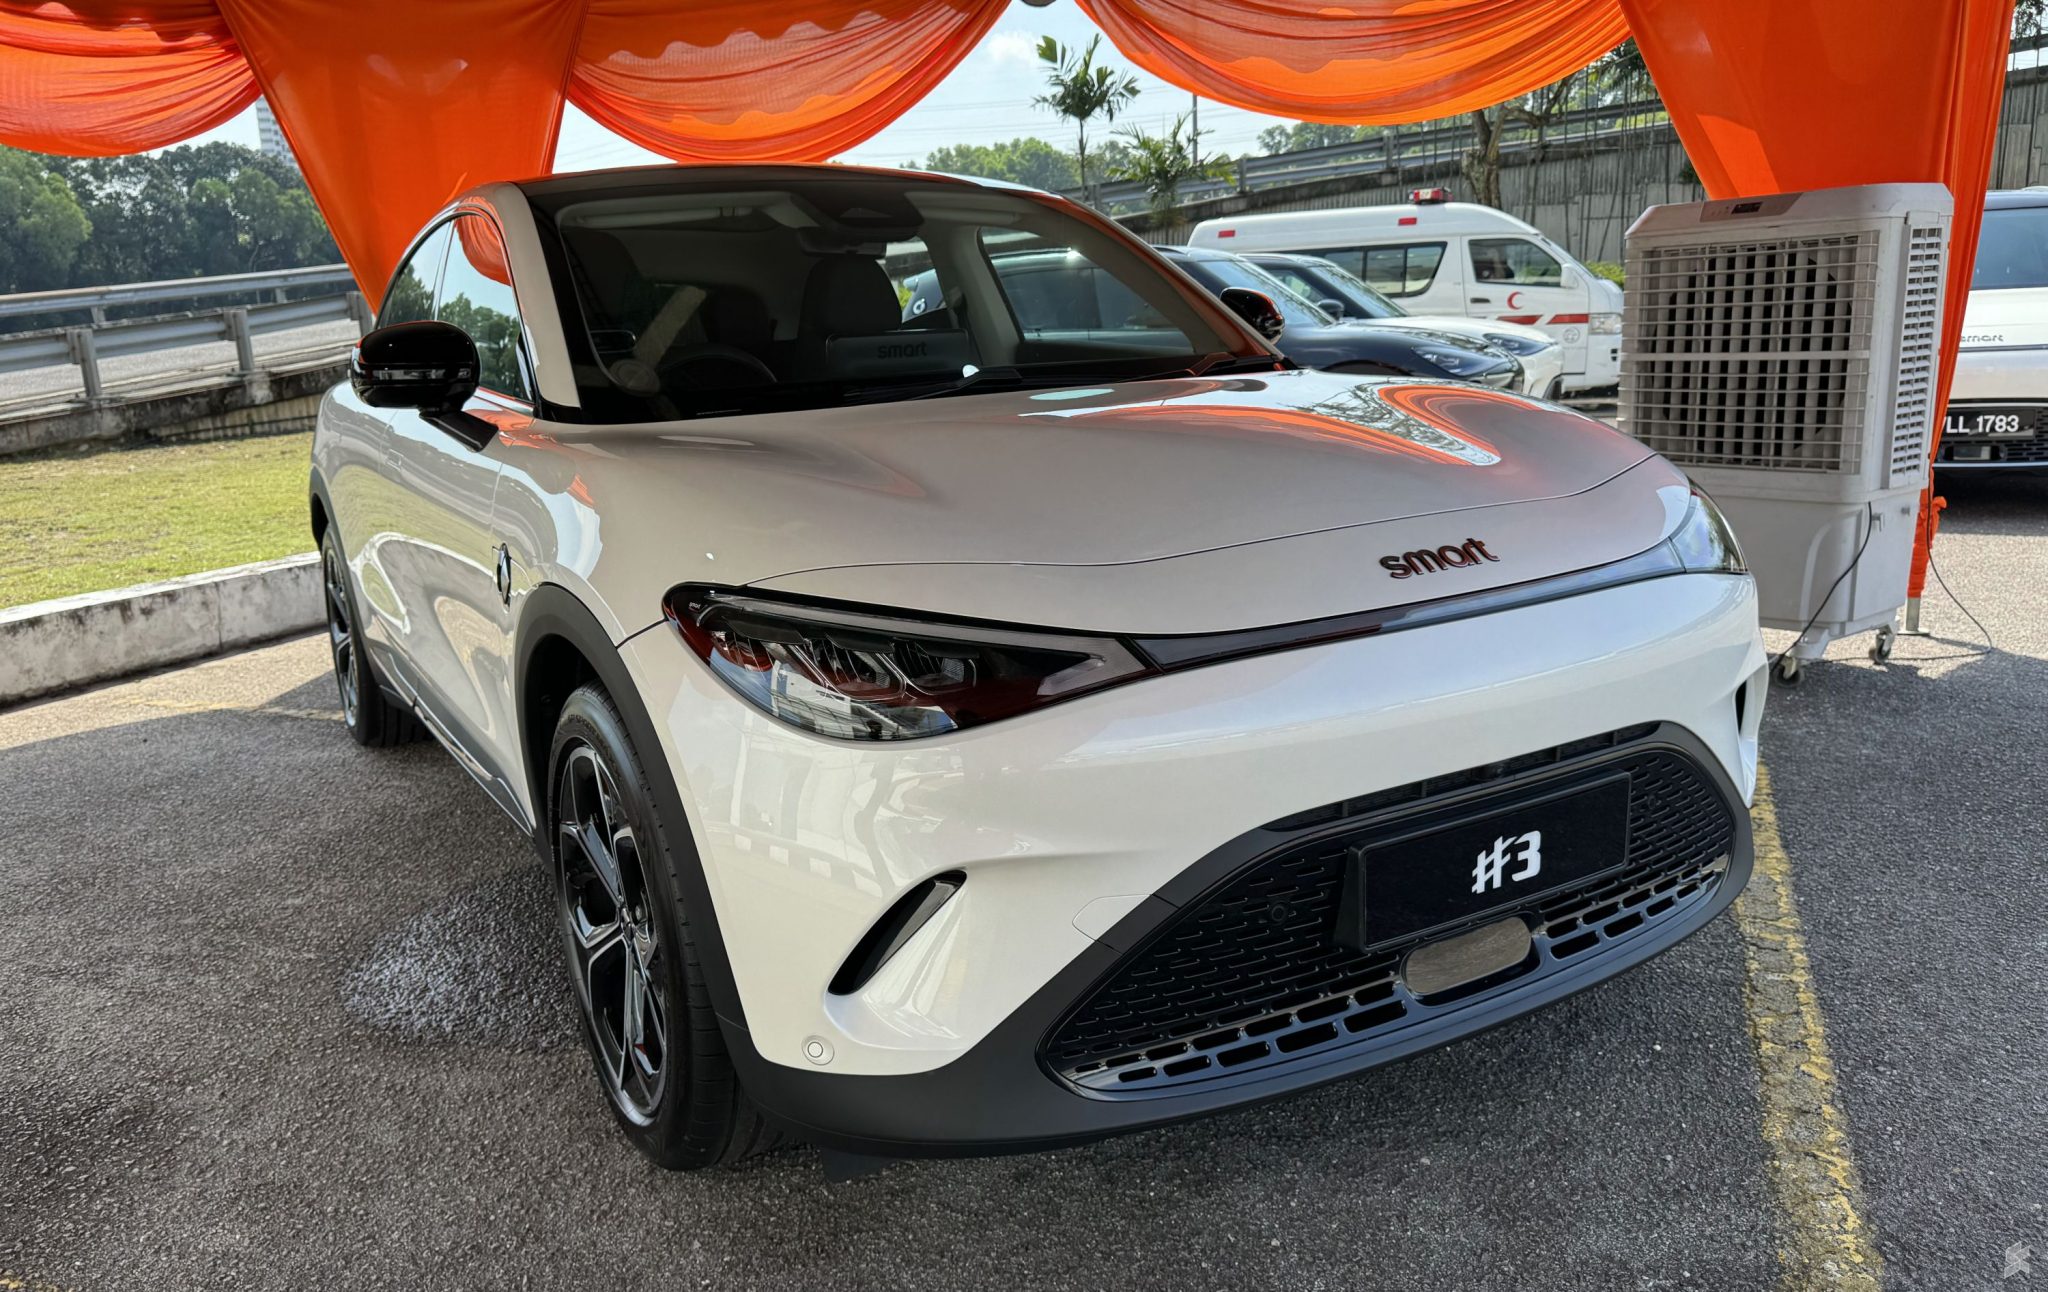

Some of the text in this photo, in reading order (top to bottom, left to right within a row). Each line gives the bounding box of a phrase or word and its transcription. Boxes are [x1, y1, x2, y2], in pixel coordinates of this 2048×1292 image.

[877, 341, 928, 359] smart
[1943, 414, 2020, 434] LL 1783
[1379, 538, 1501, 579] smart
[1471, 830, 1542, 894] #3
